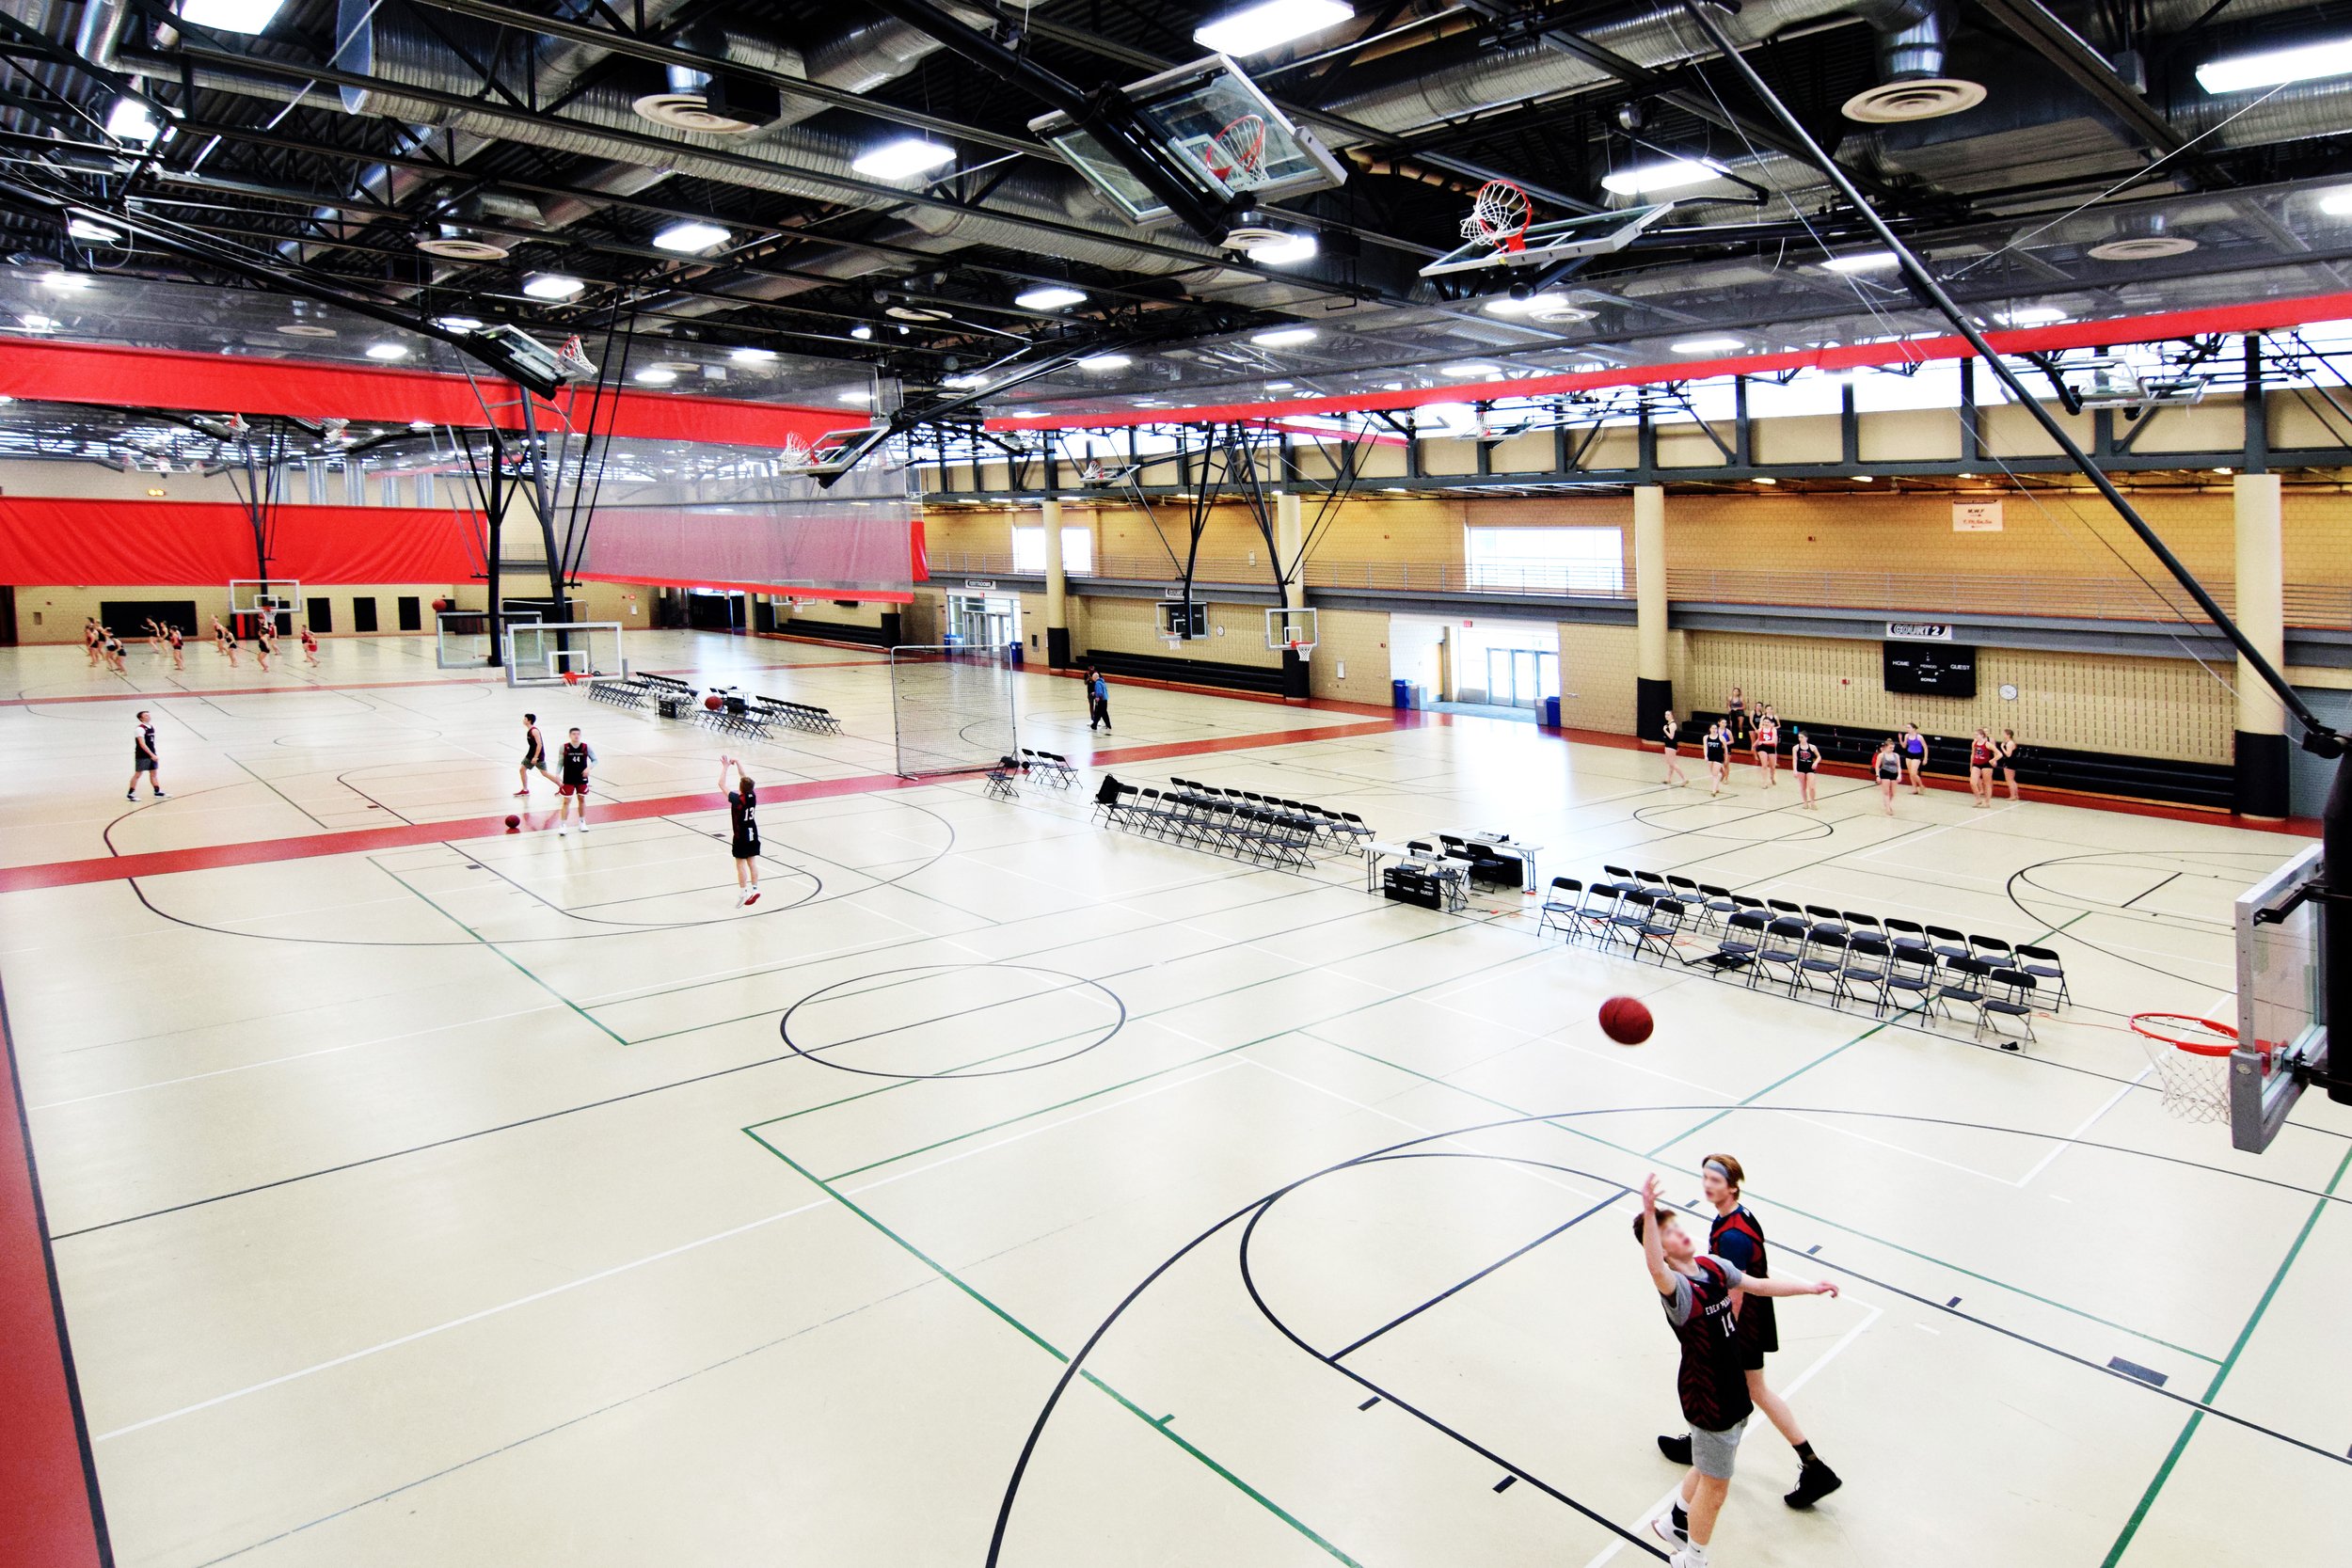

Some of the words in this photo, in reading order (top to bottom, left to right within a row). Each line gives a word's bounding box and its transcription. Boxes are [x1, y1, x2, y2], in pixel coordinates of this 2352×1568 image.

[1894, 624, 1931, 635] COURT
[1931, 626, 1940, 636] 2
[744, 807, 755, 821] 13
[1722, 1311, 1736, 1338] 14
